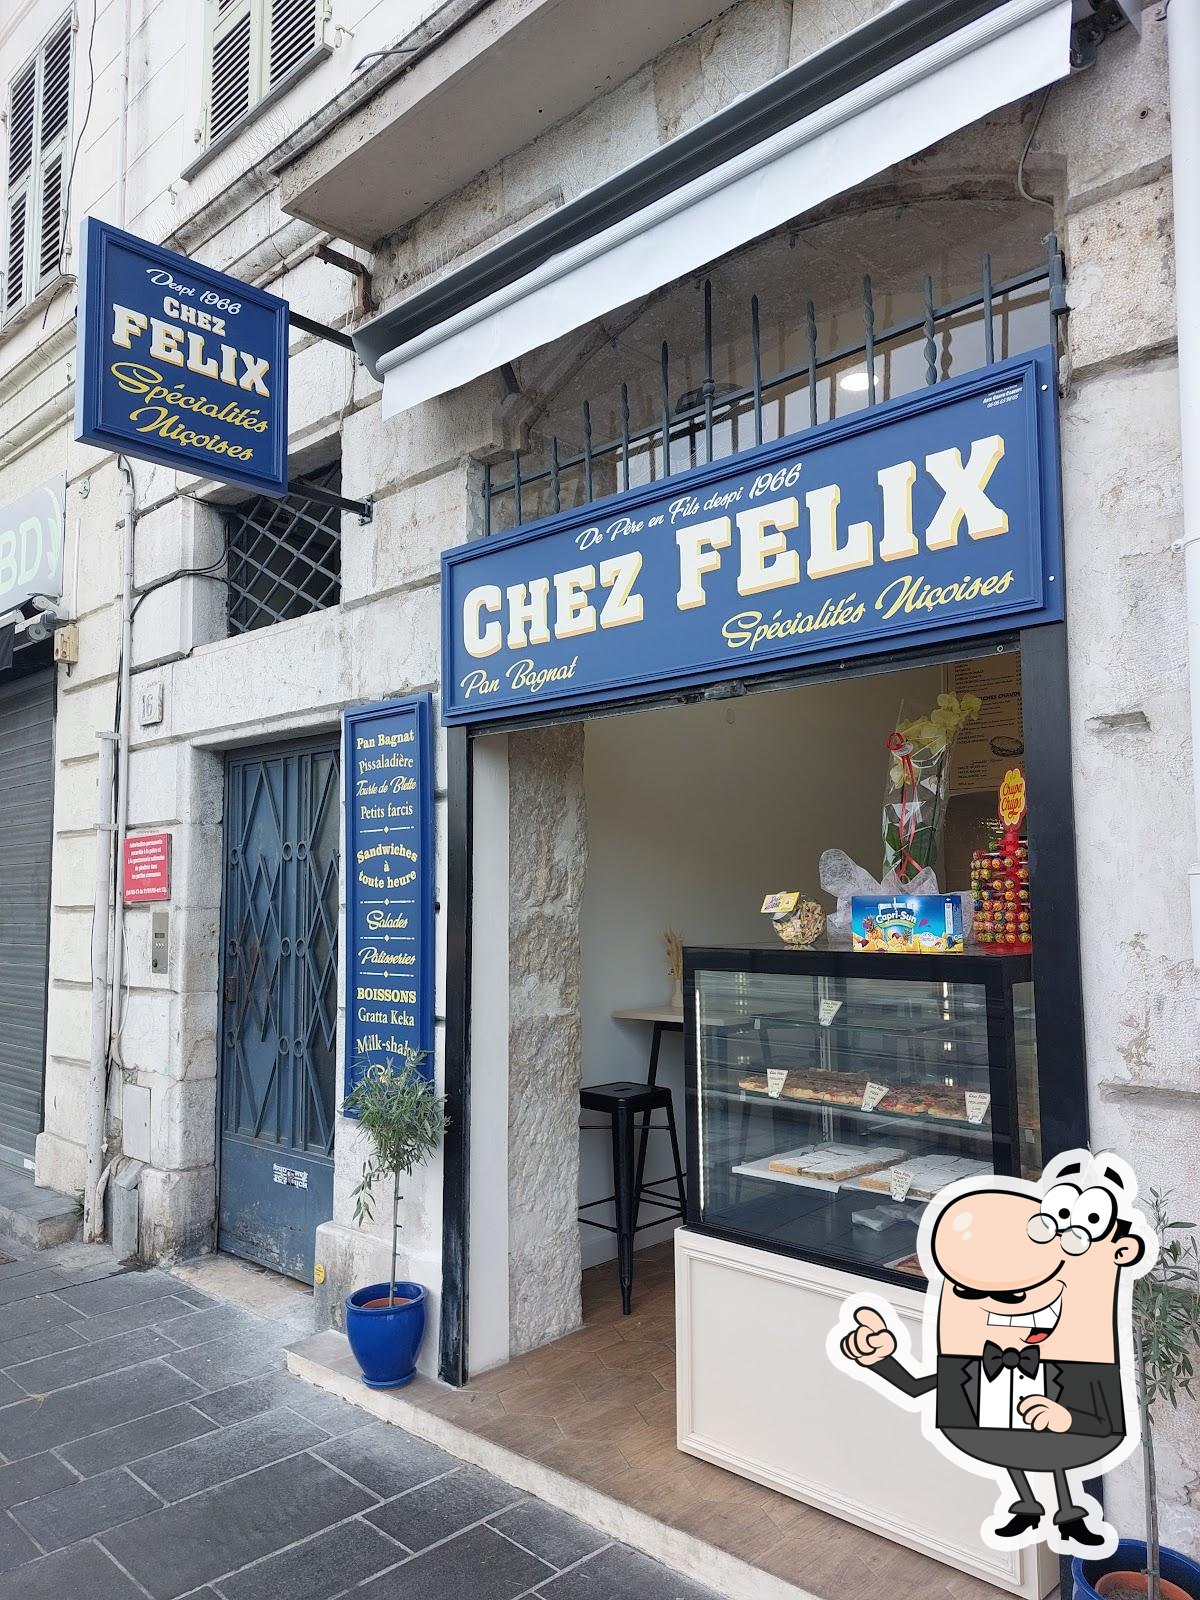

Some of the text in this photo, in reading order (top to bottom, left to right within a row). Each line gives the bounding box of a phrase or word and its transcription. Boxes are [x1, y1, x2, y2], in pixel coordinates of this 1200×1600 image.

[146, 268, 242, 315] Despi 1966
[163, 296, 227, 336] CHEZ
[112, 303, 271, 398] FELIX
[111, 361, 269, 434] Spécialités
[130, 406, 254, 462] Niçoises
[575, 462, 803, 552] De Père en Fils despi 1966
[462, 434, 1010, 659] CHEZ FELIX
[721, 569, 1014, 652] Spécialités Niçoises
[460, 656, 578, 700] Pan Bagnat
[141, 693, 153, 719] 16
[356, 729, 415, 750] Pan Bagnat
[359, 753, 414, 775] Pissaladière
[356, 776, 417, 796] Tourte de Blette
[360, 801, 414, 820] Petits farcis
[357, 843, 418, 864] Sandwiches
[383, 860, 390, 872] à
[358, 870, 417, 889] toute heure
[366, 910, 408, 930] Salades
[876, 909, 917, 924] Capri-Sun
[357, 987, 417, 1004] BOISSONS
[358, 1007, 415, 1027] Gratta Keka
